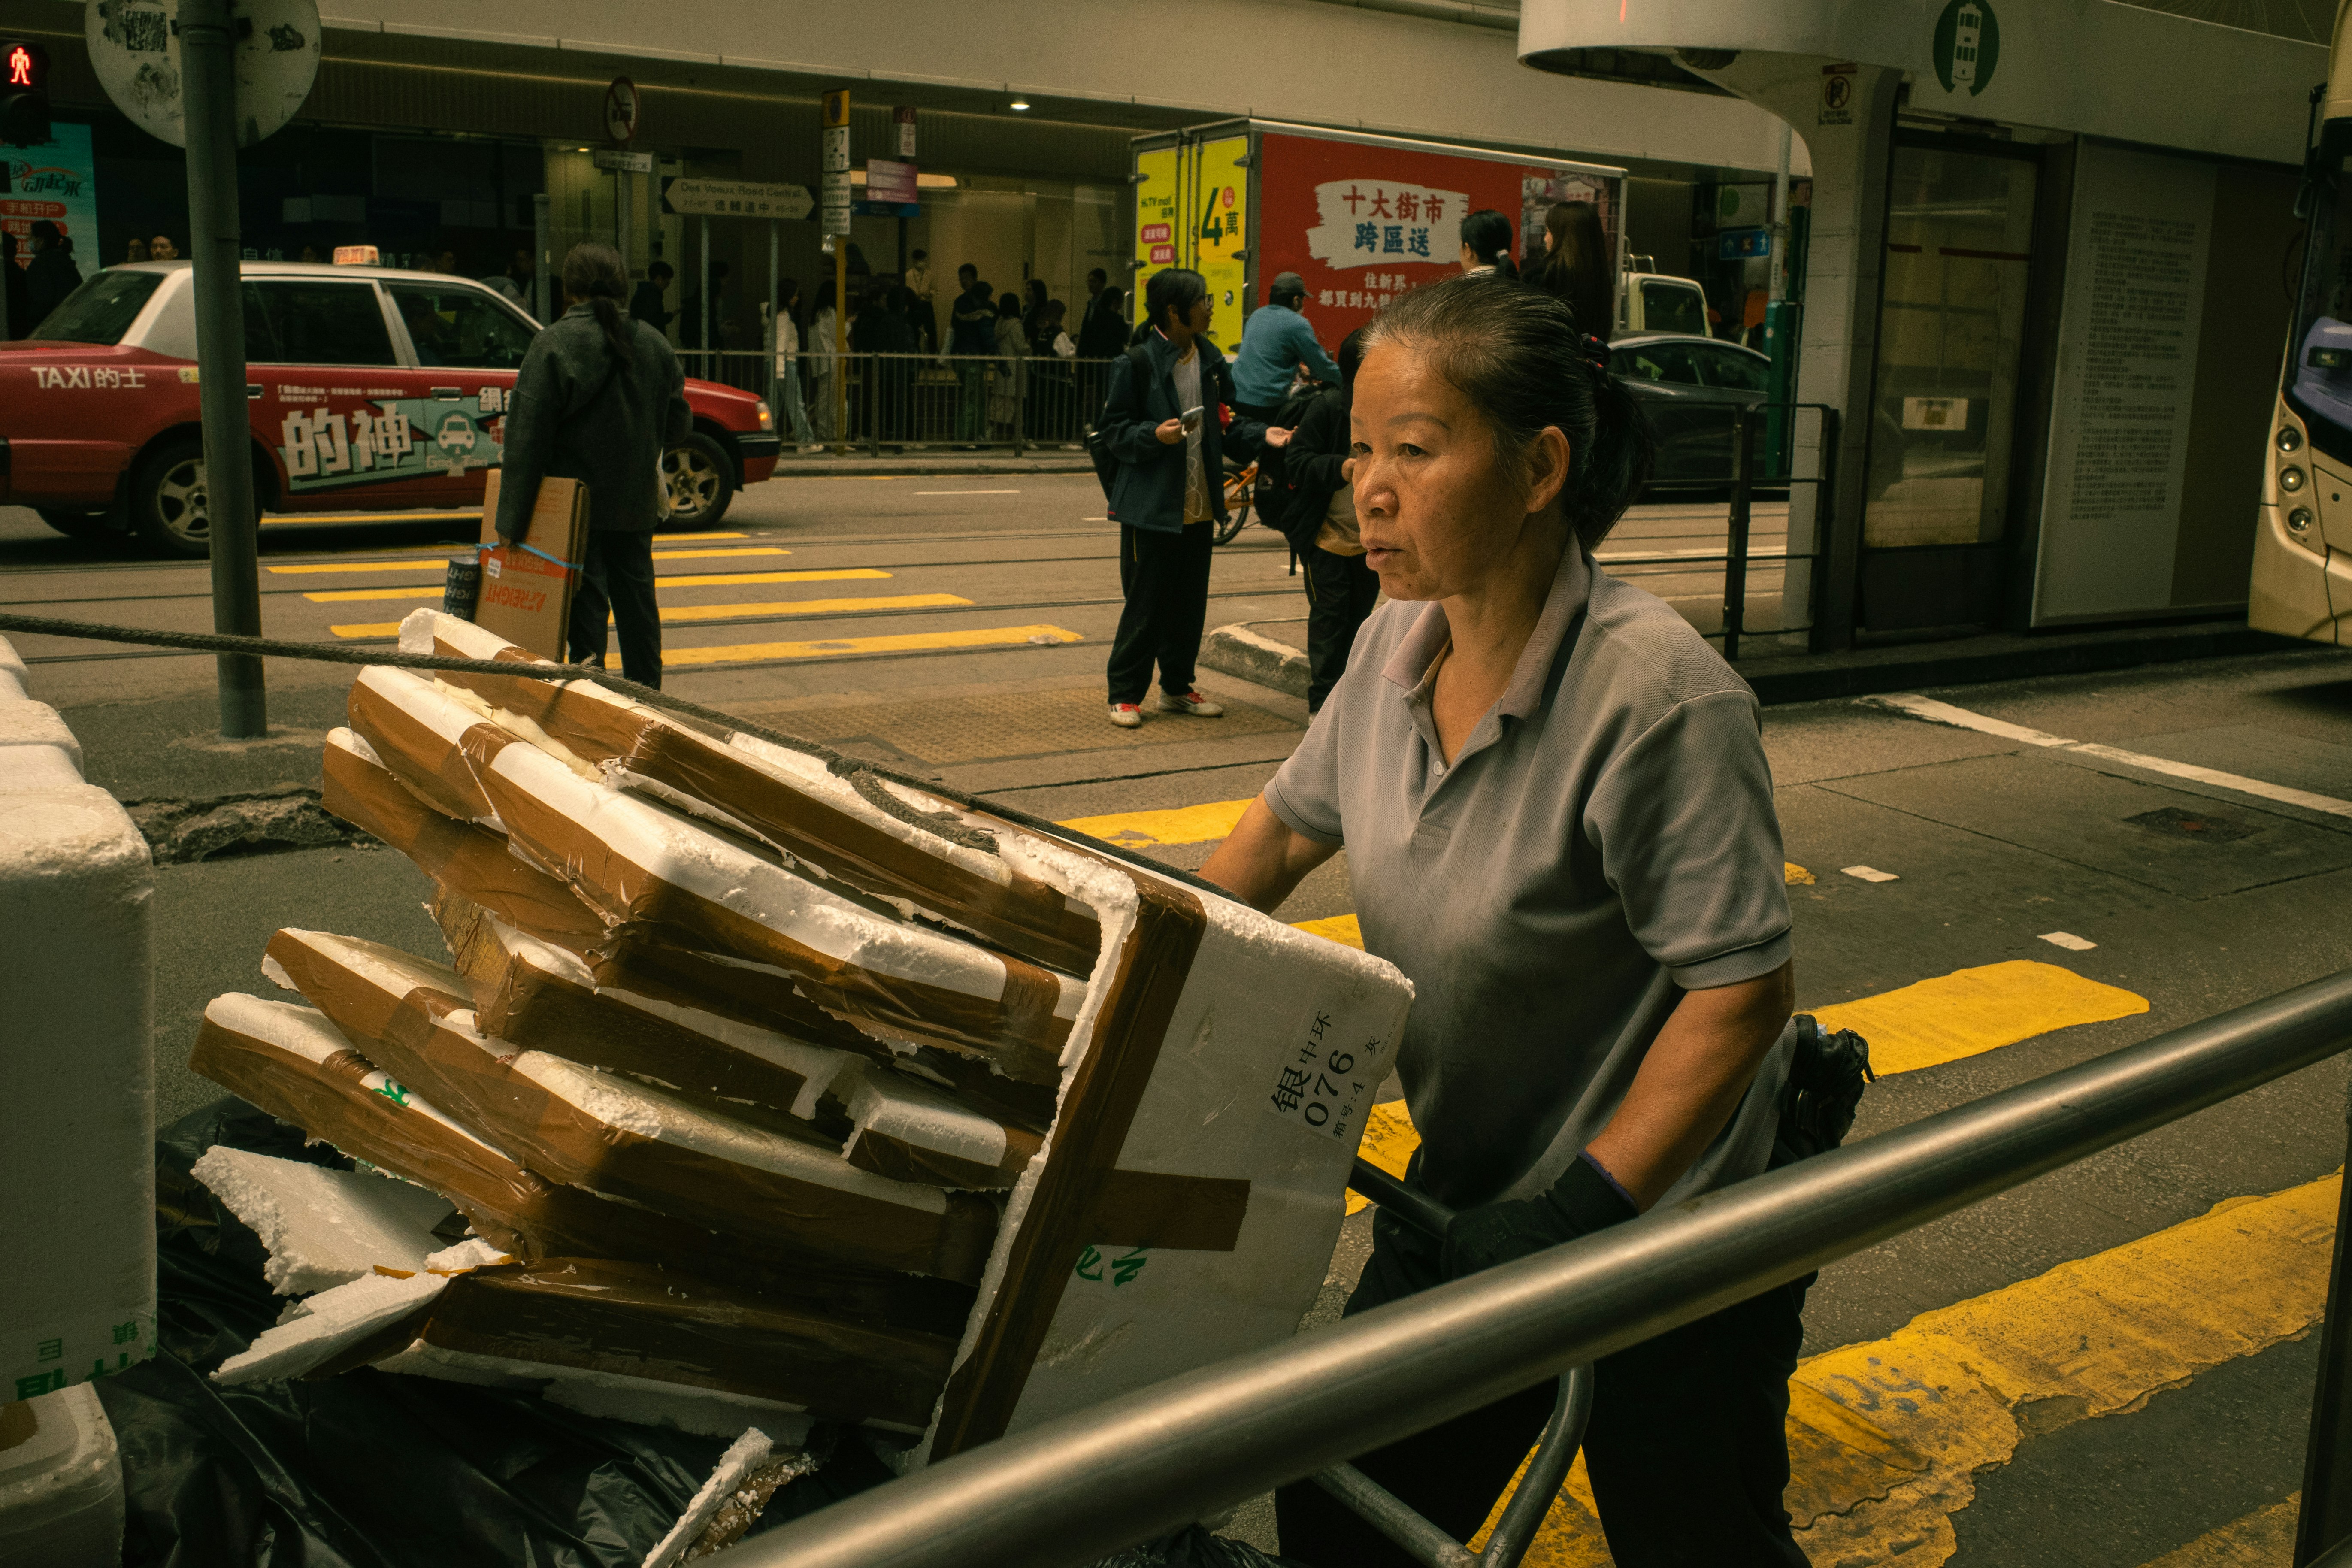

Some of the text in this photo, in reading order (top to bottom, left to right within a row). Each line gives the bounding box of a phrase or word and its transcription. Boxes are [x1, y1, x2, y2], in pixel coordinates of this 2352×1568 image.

[681, 182, 801, 198] Des Voeux Road Central
[1342, 185, 1445, 224] 十大街市
[1353, 221, 1431, 257] 跨區送
[31, 367, 145, 389] TAXI 的士
[281, 403, 414, 477] 的神
[1304, 1050, 1354, 1127] 076
